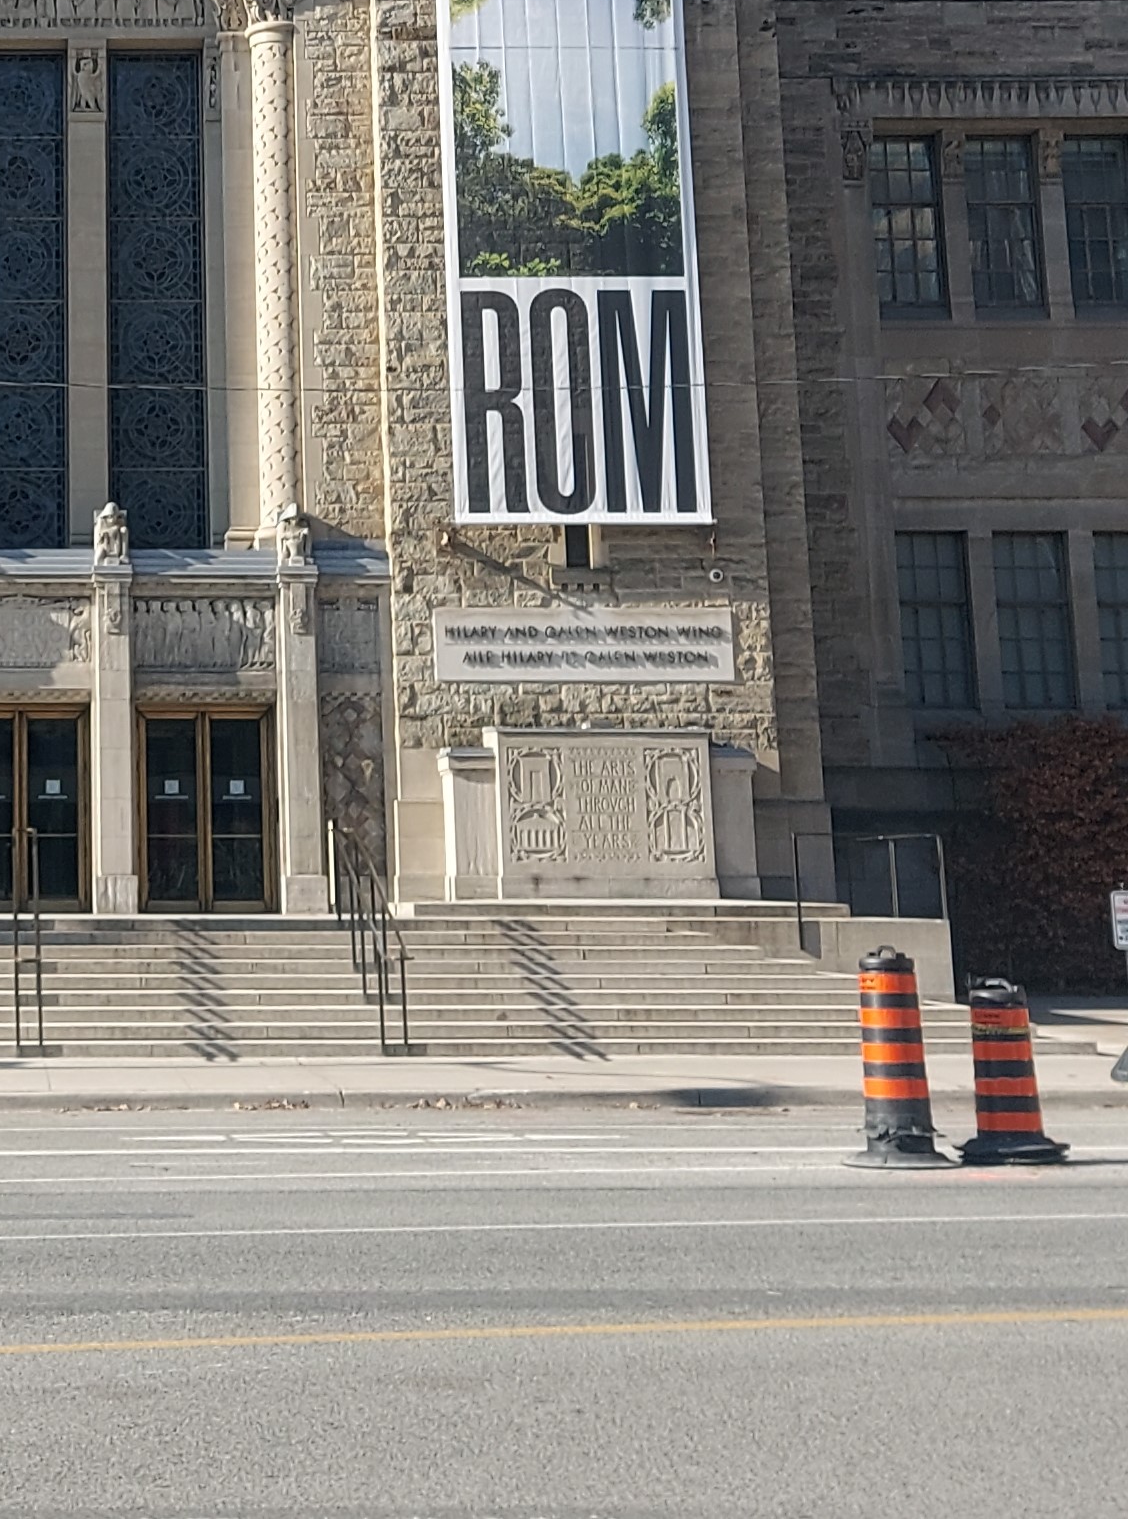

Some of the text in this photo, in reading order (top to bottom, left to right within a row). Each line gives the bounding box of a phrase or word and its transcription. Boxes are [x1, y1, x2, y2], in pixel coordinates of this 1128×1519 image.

[460, 288, 698, 515] ROM
[444, 625, 497, 639] HILARY
[504, 625, 538, 639] AND
[604, 625, 669, 639] WESTON
[501, 650, 554, 664] HILARY
[643, 650, 709, 664] WESTON
[601, 760, 636, 776] ARTS
[599, 779, 631, 794] MAN
[583, 833, 632, 849] YEARS
